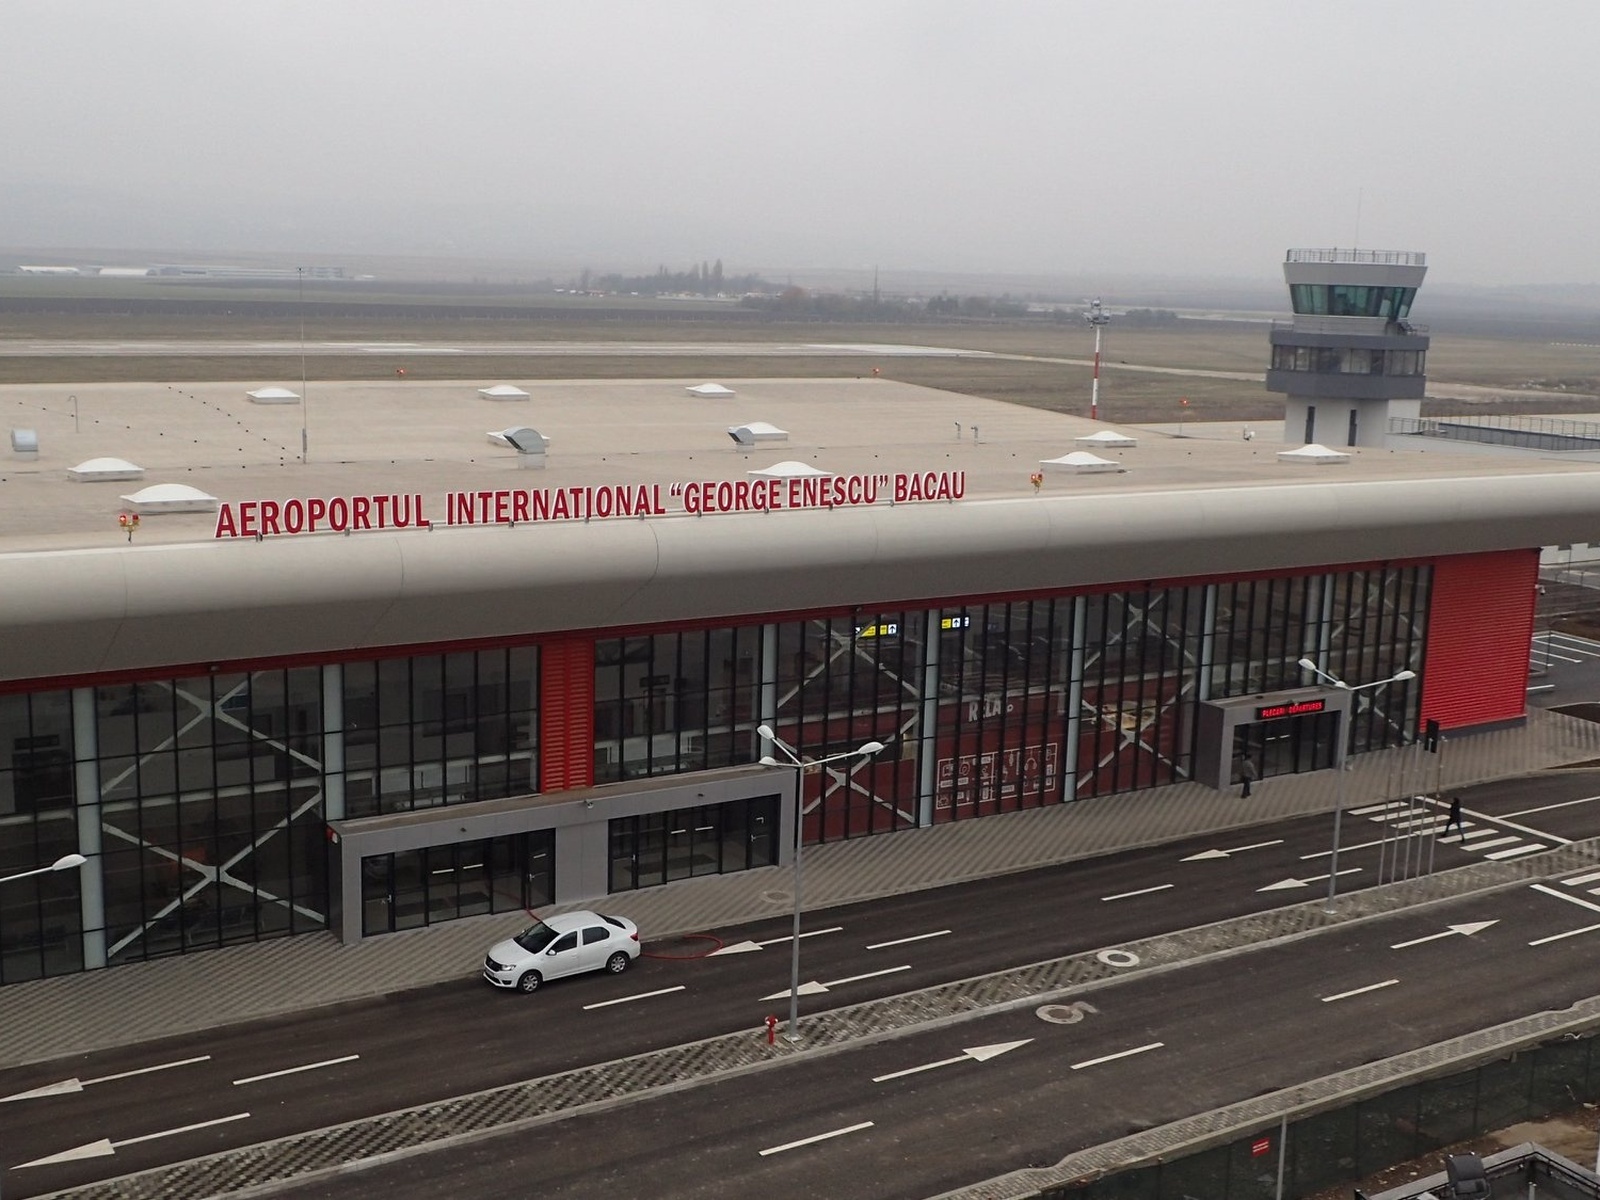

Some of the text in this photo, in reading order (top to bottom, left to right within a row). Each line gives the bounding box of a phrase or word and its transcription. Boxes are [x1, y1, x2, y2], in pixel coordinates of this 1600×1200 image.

[215, 471, 965, 538] AEROPORTUL INTERNATIONAL “GEORGE ENESCU” BACAU
